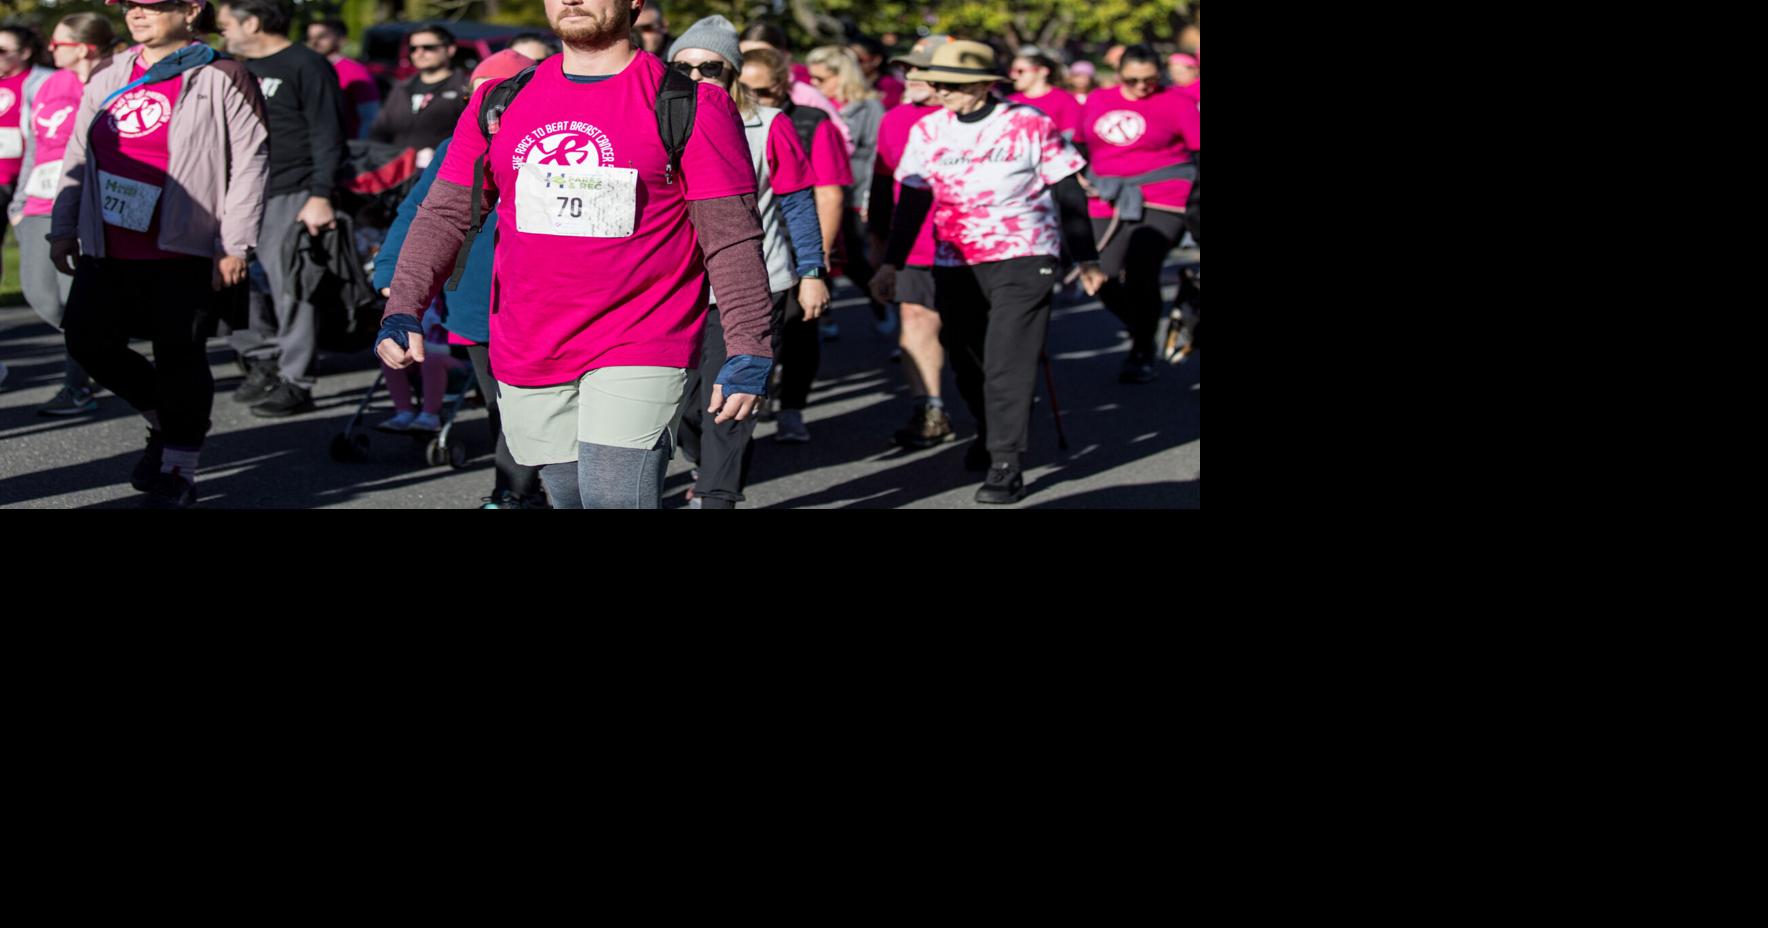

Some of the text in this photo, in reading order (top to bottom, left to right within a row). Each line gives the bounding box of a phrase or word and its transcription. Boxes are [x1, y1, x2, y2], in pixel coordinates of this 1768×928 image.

[514, 135, 535, 155] RACE
[531, 127, 546, 139] TO
[545, 121, 569, 134] BEAT
[569, 121, 602, 138] BREAST
[595, 134, 615, 163] CANCER
[104, 195, 126, 214] 271
[557, 196, 583, 218] 70
